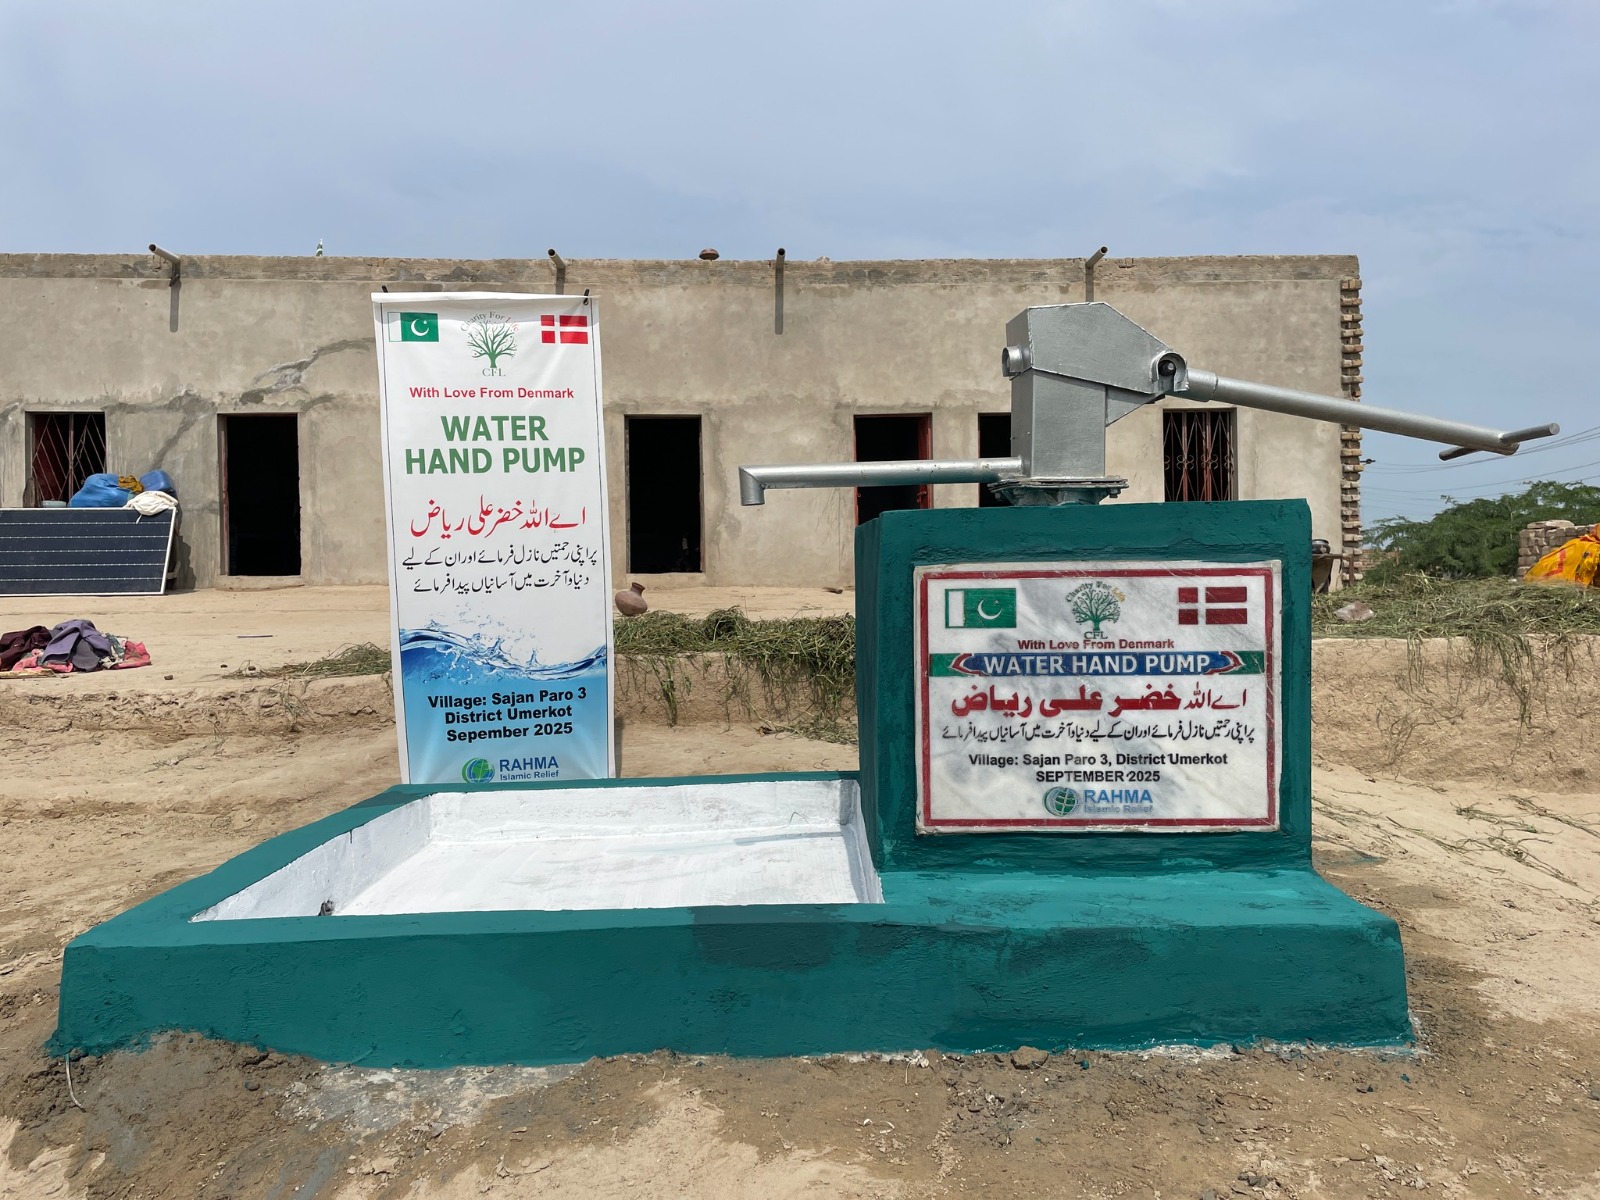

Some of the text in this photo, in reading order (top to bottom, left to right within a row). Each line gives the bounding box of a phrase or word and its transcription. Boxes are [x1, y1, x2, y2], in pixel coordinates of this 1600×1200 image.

[461, 313, 487, 331] Charity
[489, 311, 506, 320] For
[482, 368, 506, 377] CFL
[409, 387, 574, 399] With Love From Denmark
[441, 415, 549, 442] WATER
[405, 447, 585, 475] HAND PUMP
[410, 500, 465, 539] ریاض
[467, 494, 494, 535] علی
[484, 500, 523, 538] خضر
[549, 506, 586, 529] اے
[424, 546, 443, 565] کے
[444, 552, 460, 567] ان
[461, 551, 476, 564] اور
[478, 544, 514, 566] فرمائے
[514, 544, 540, 564] نازل
[541, 542, 570, 563] رحمتیں
[571, 544, 589, 566] اپنی
[588, 550, 598, 566] پر
[414, 573, 450, 594] فرمائے
[452, 578, 469, 594] پیدا
[472, 572, 516, 594] آسانیاں
[515, 573, 532, 590] میں
[1065, 583, 1093, 602] Charity
[1018, 639, 1174, 650] With Love From Denmark
[1084, 631, 1108, 640] CFL
[983, 654, 1210, 675] WATER HAND PUMP
[428, 687, 586, 710] Village: Sajan Paro 3
[952, 684, 1032, 718] ریاض
[1040, 684, 1103, 718] علی
[1108, 684, 1182, 718] خضر
[1211, 688, 1247, 710] اے
[445, 705, 573, 724] District Umerkot
[446, 722, 573, 744] Sepember 2025
[1025, 724, 1041, 741] میں
[1107, 720, 1122, 738] کے
[1124, 726, 1138, 740] ان
[1138, 726, 1150, 738] اور
[1182, 720, 1204, 740] نازل
[1205, 719, 1230, 740] رحمتیں
[1231, 722, 1248, 744] اپنی
[1246, 728, 1255, 744] پر
[500, 756, 559, 772] RAHMA
[968, 753, 1228, 768] Village: Sajan Paro 3, District Umerkot
[500, 770, 560, 781] Islamic Relief
[1036, 770, 1160, 782] SEPTEMBER 2025
[1084, 790, 1153, 804] RAHMA
[1084, 804, 1153, 814] Islamic Relief
